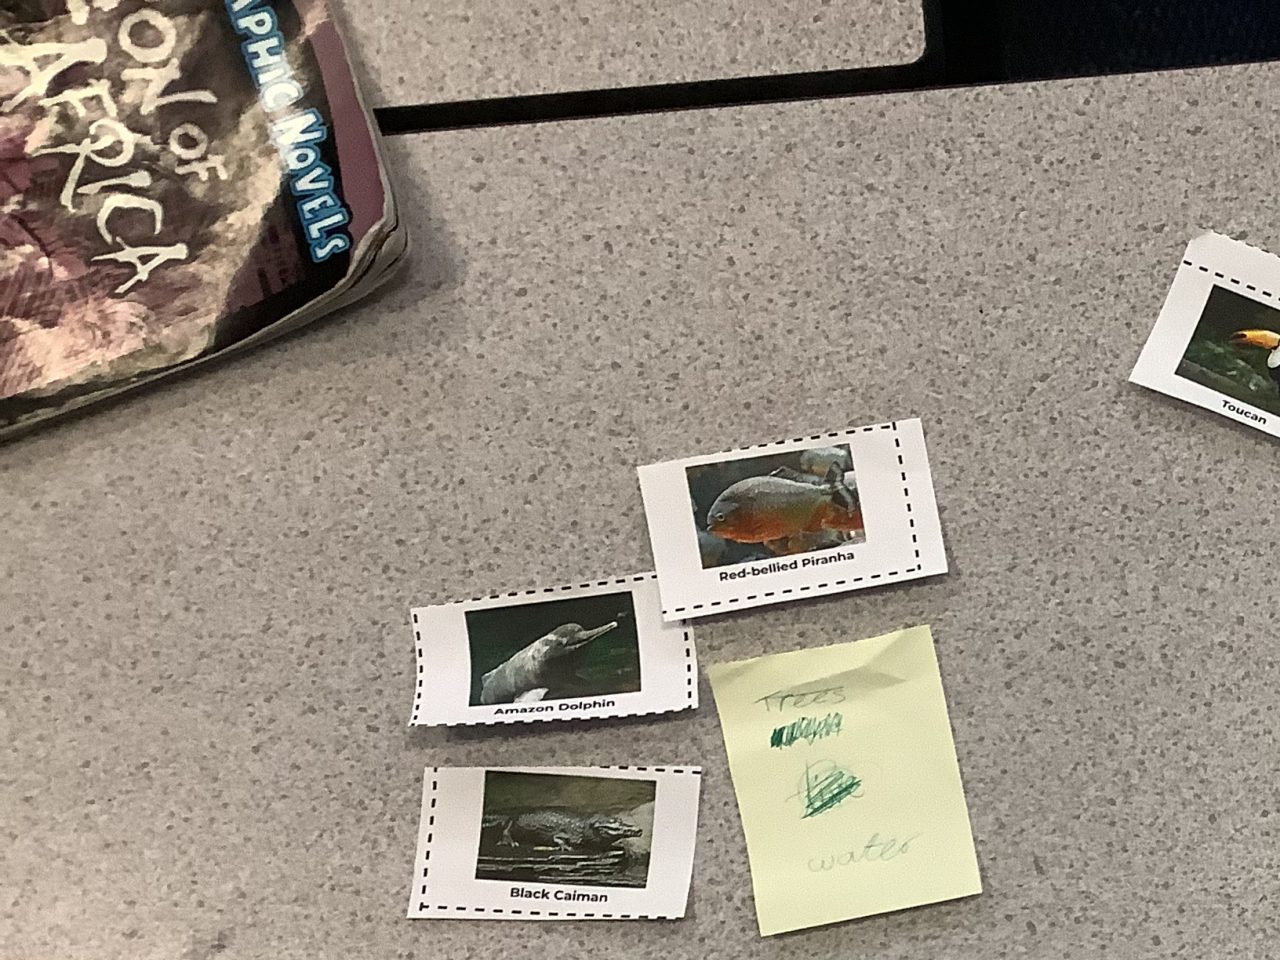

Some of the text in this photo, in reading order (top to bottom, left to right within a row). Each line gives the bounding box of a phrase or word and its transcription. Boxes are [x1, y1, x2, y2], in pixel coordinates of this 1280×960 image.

[0, 28, 189, 294] AFRICA
[169, 122, 229, 181] OF
[1222, 399, 1267, 425] Toucan
[719, 552, 855, 582] Red-bellied Piranha
[494, 699, 615, 715] Amazon Dolphin
[807, 832, 921, 873] water
[510, 887, 608, 903] Black Caiman
